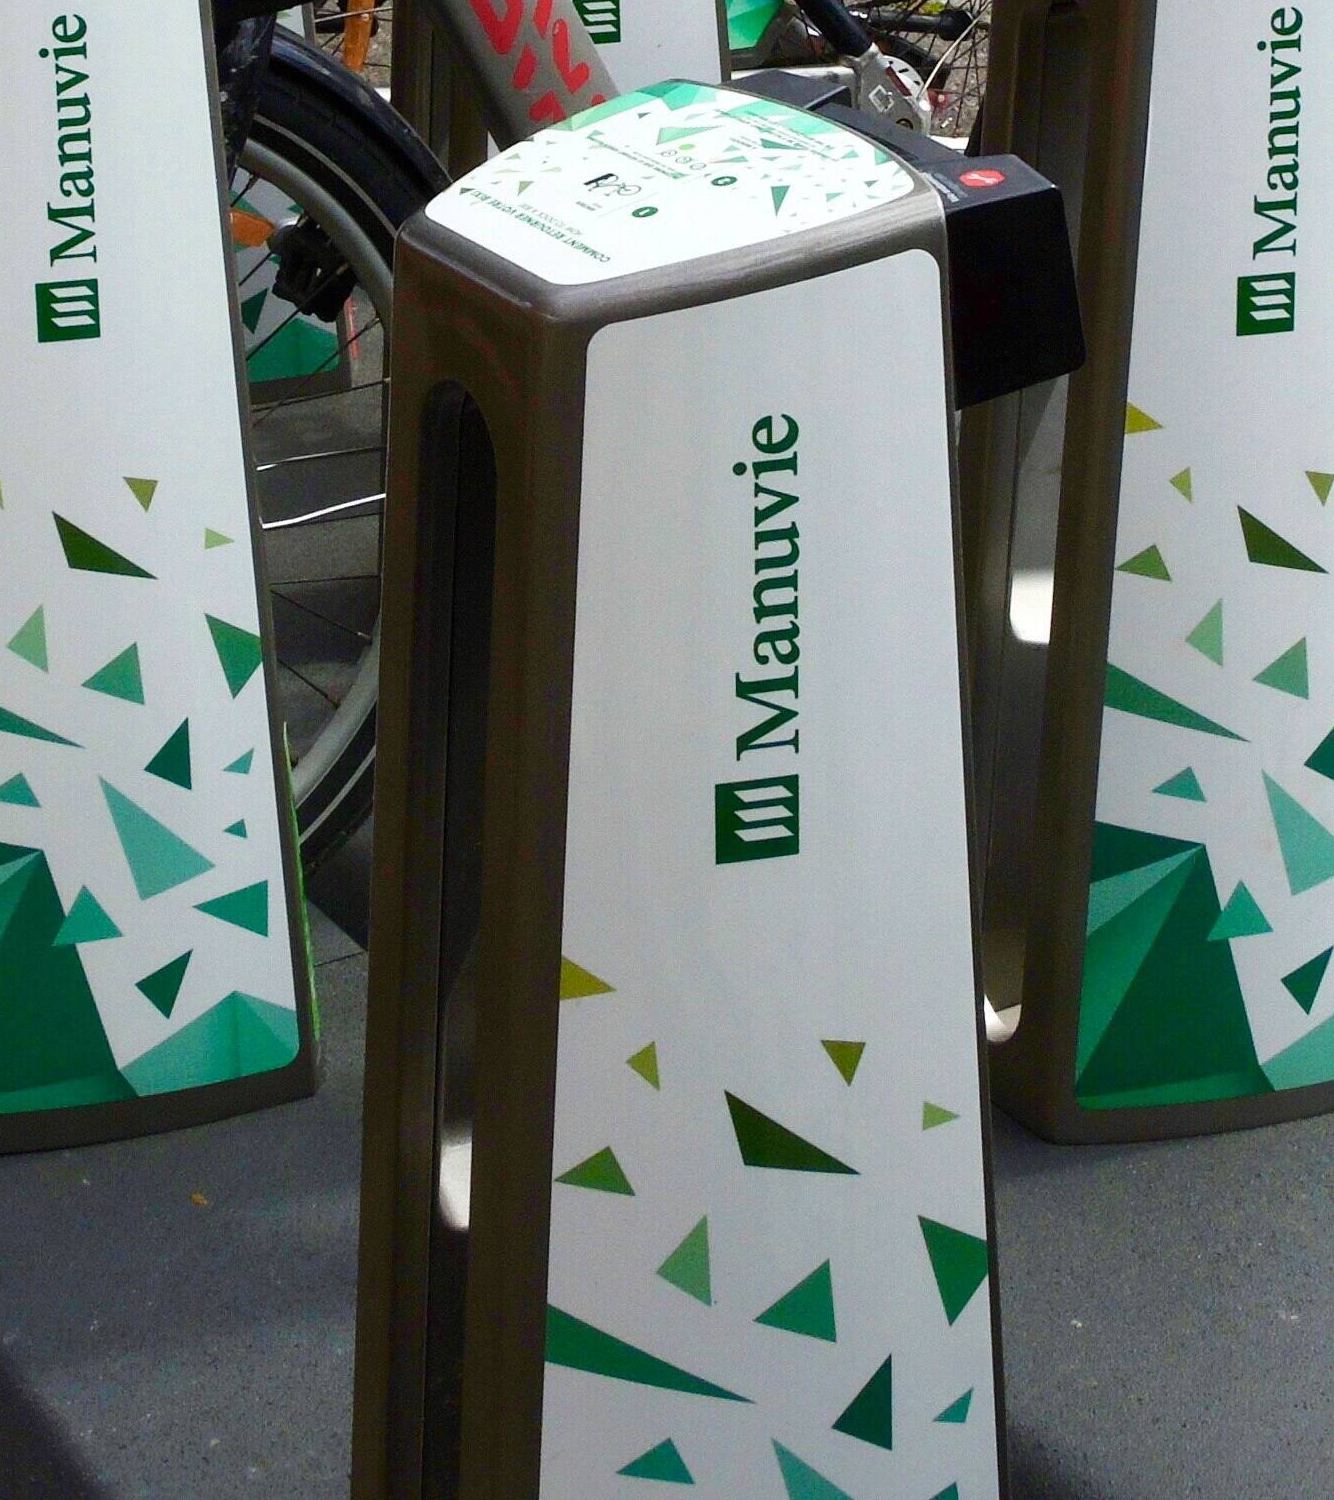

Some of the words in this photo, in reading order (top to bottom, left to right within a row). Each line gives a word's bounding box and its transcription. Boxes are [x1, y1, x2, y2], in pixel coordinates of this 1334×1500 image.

[39, 13, 99, 265] Manuvie
[1257, 6, 1304, 258] Manuvie
[732, 412, 802, 763] Manuvie
